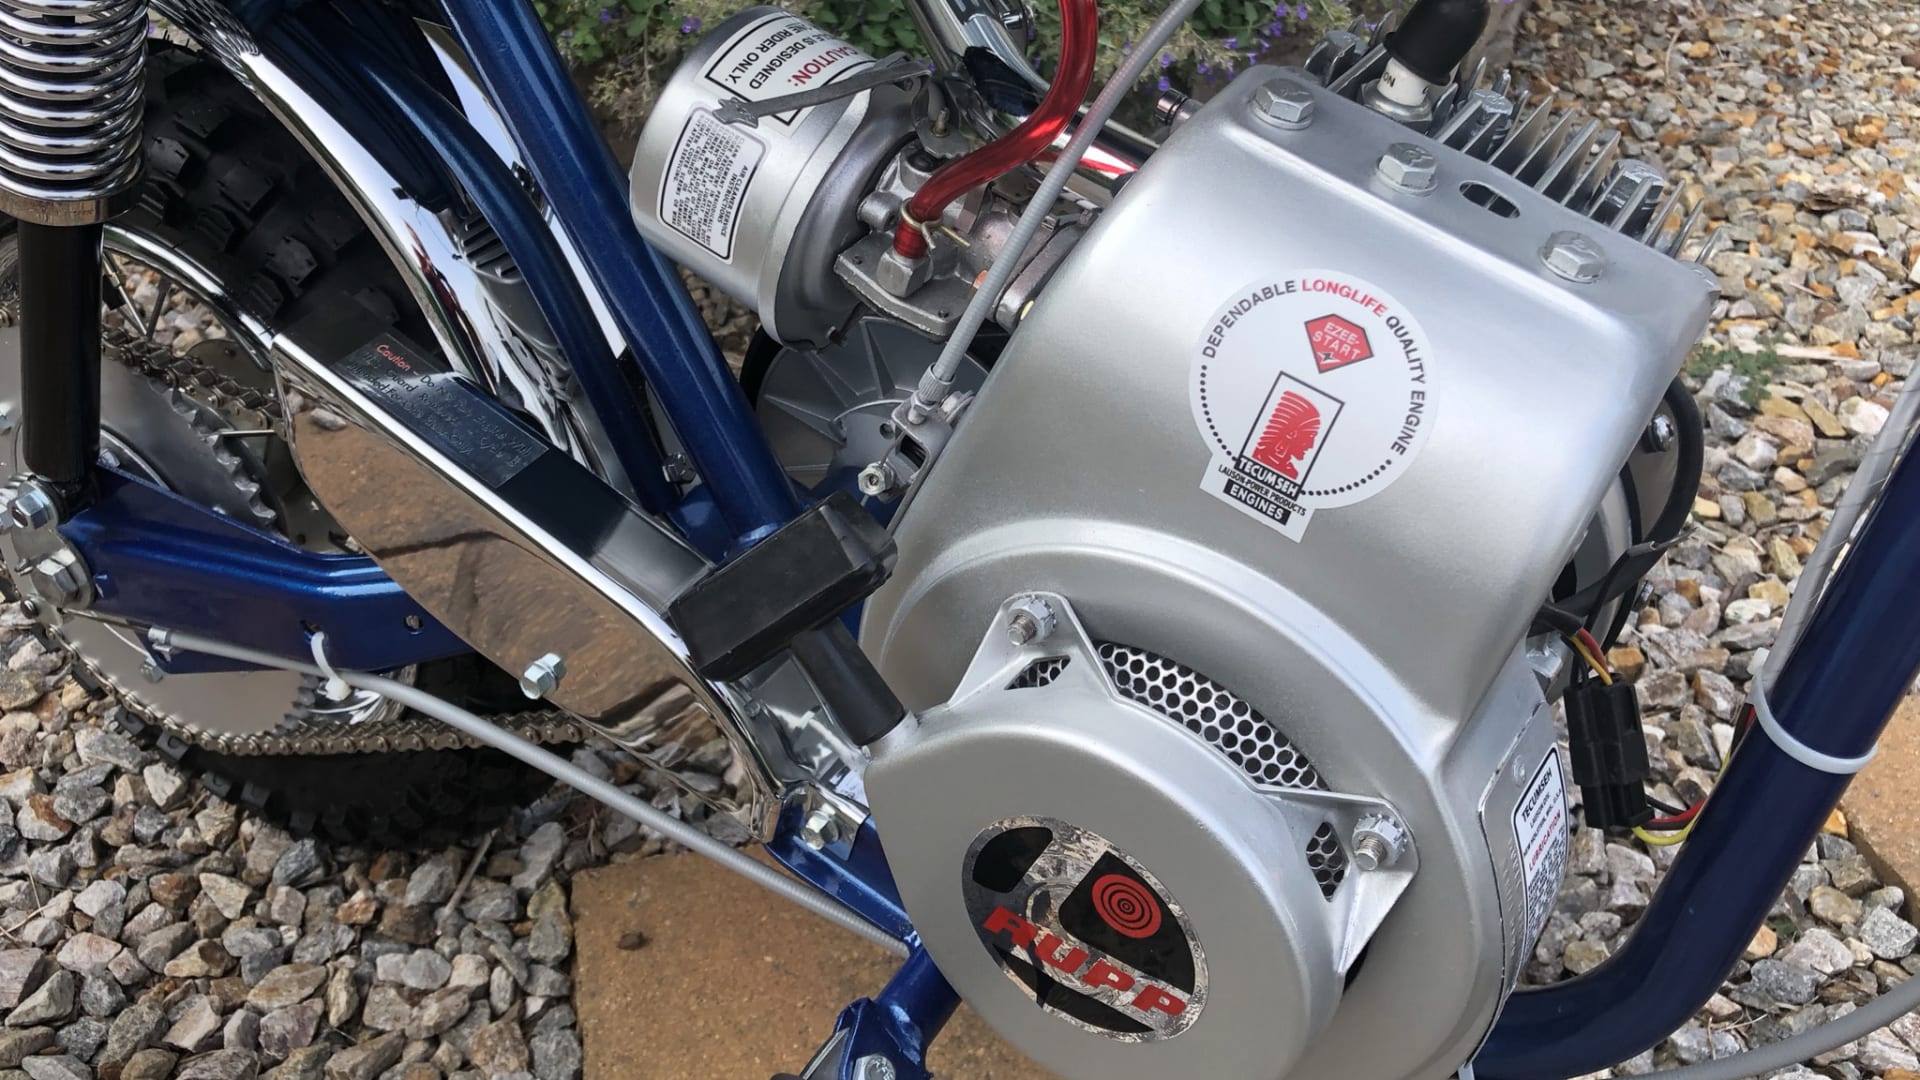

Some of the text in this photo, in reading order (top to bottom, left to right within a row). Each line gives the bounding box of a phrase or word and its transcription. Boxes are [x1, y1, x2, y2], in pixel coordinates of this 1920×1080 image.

[755, 29, 794, 54] RIDER
[802, 36, 818, 46] IS
[724, 47, 762, 84] ONLY.
[750, 41, 806, 89] DESIGNED
[787, 46, 859, 87] CAUTION:
[712, 155, 729, 188] FREQUENT
[719, 159, 733, 189] ELEMENT
[717, 173, 737, 224] INSTRUCTIONS
[721, 165, 749, 237] AIR CLEANER SERVICE
[376, 344, 412, 372] Caution
[1312, 331, 1361, 359] START
[1202, 279, 1426, 456] DEPENDABLE LONGLIFE QUALITY ENGINE
[1239, 458, 1299, 498] TECUMSEH
[1230, 484, 1284, 520] ENGINES
[1269, 493, 1307, 517] PRODUCTS
[1522, 767, 1552, 822] TECUMSEH
[1528, 808, 1560, 871] LUBRICATION
[983, 905, 1187, 1016] RUPP
